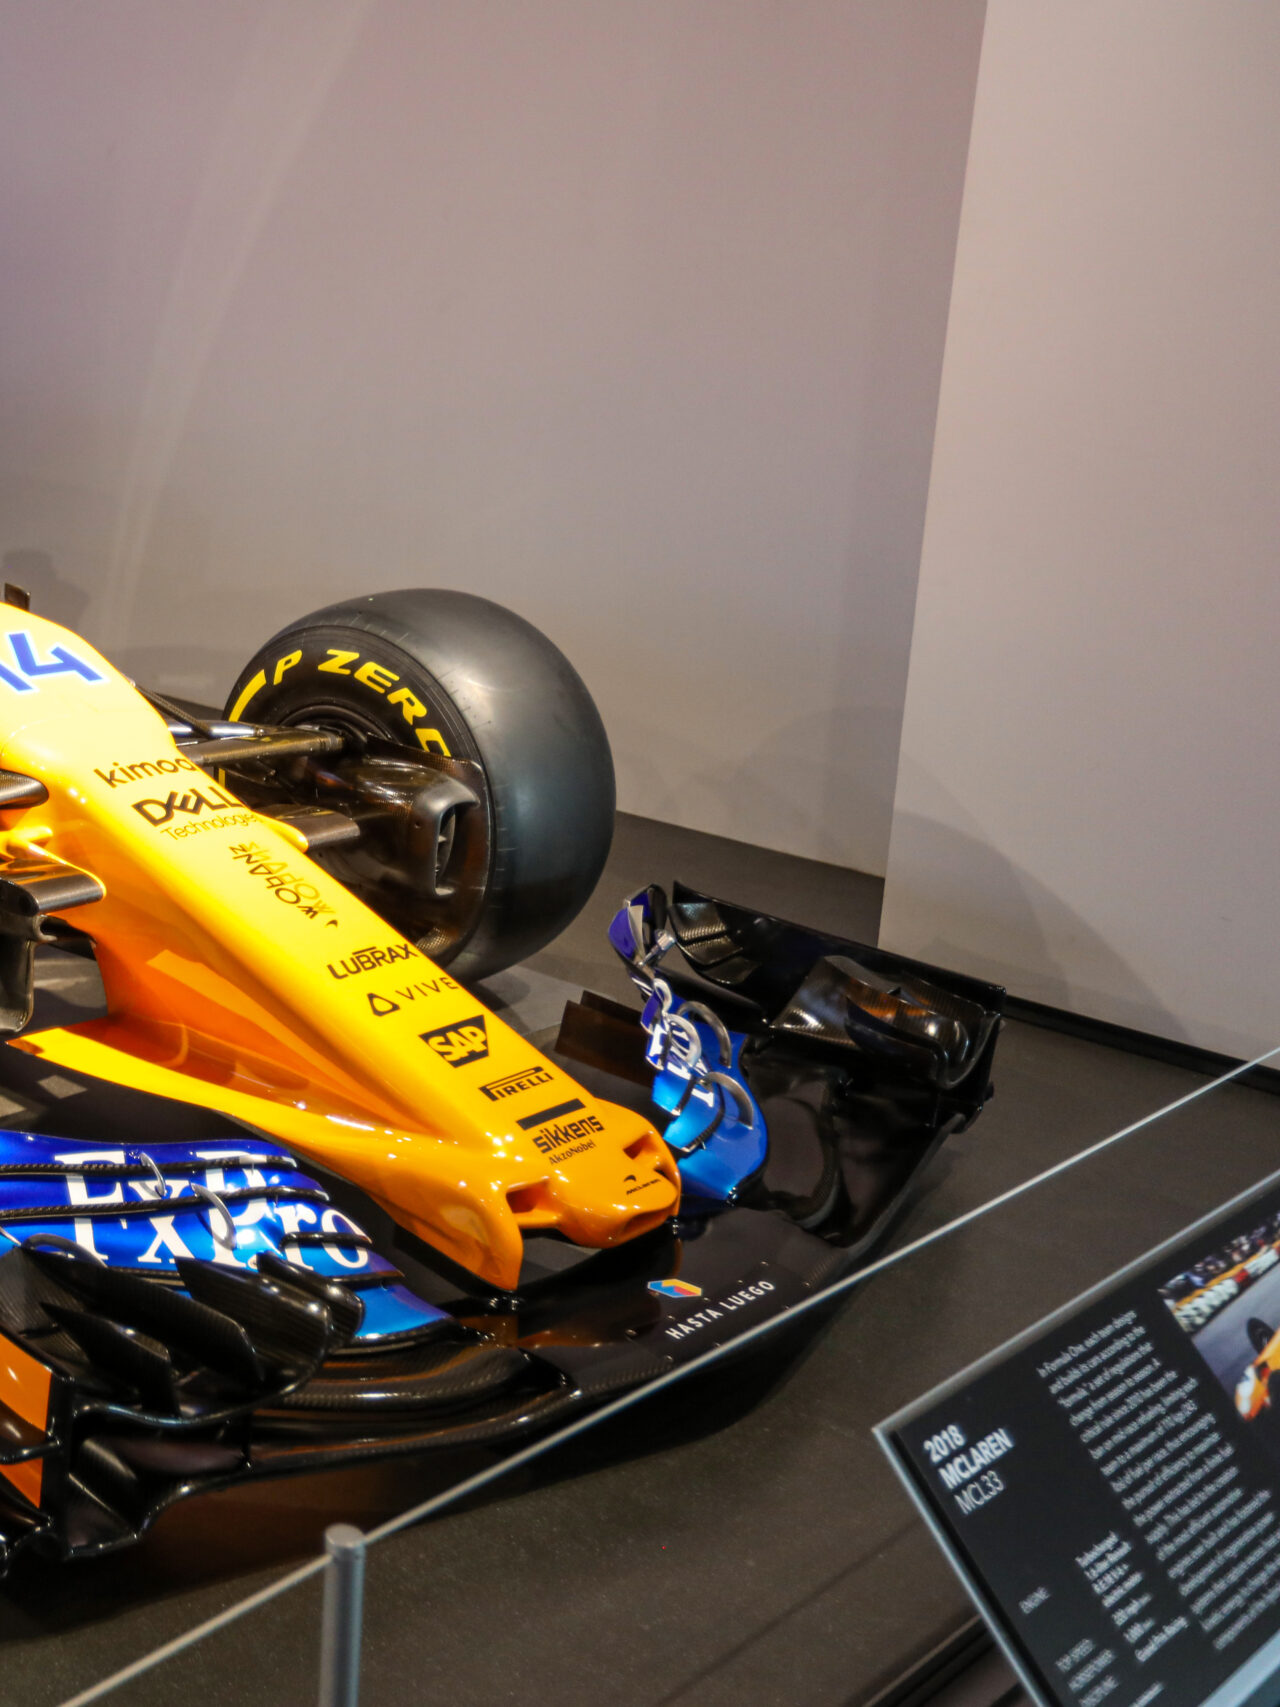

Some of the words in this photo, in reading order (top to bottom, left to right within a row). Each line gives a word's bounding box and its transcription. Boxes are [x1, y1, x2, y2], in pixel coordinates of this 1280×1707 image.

[273, 649, 302, 685] P
[131, 786, 245, 827] DELL
[327, 944, 418, 979] LUBRAX
[395, 977, 458, 1000] VIVE
[428, 1026, 487, 1062] SAP
[479, 1066, 554, 1101] PIRELLI
[548, 1139, 596, 1165] AkzoNobel
[55, 1150, 374, 1272] FxPro
[665, 1308, 723, 1339] HASTA
[719, 1281, 775, 1310] LUEGO
[924, 1424, 965, 1463] 2018
[938, 1428, 1014, 1489] MCLAREN
[954, 1470, 1004, 1514] MCL33
